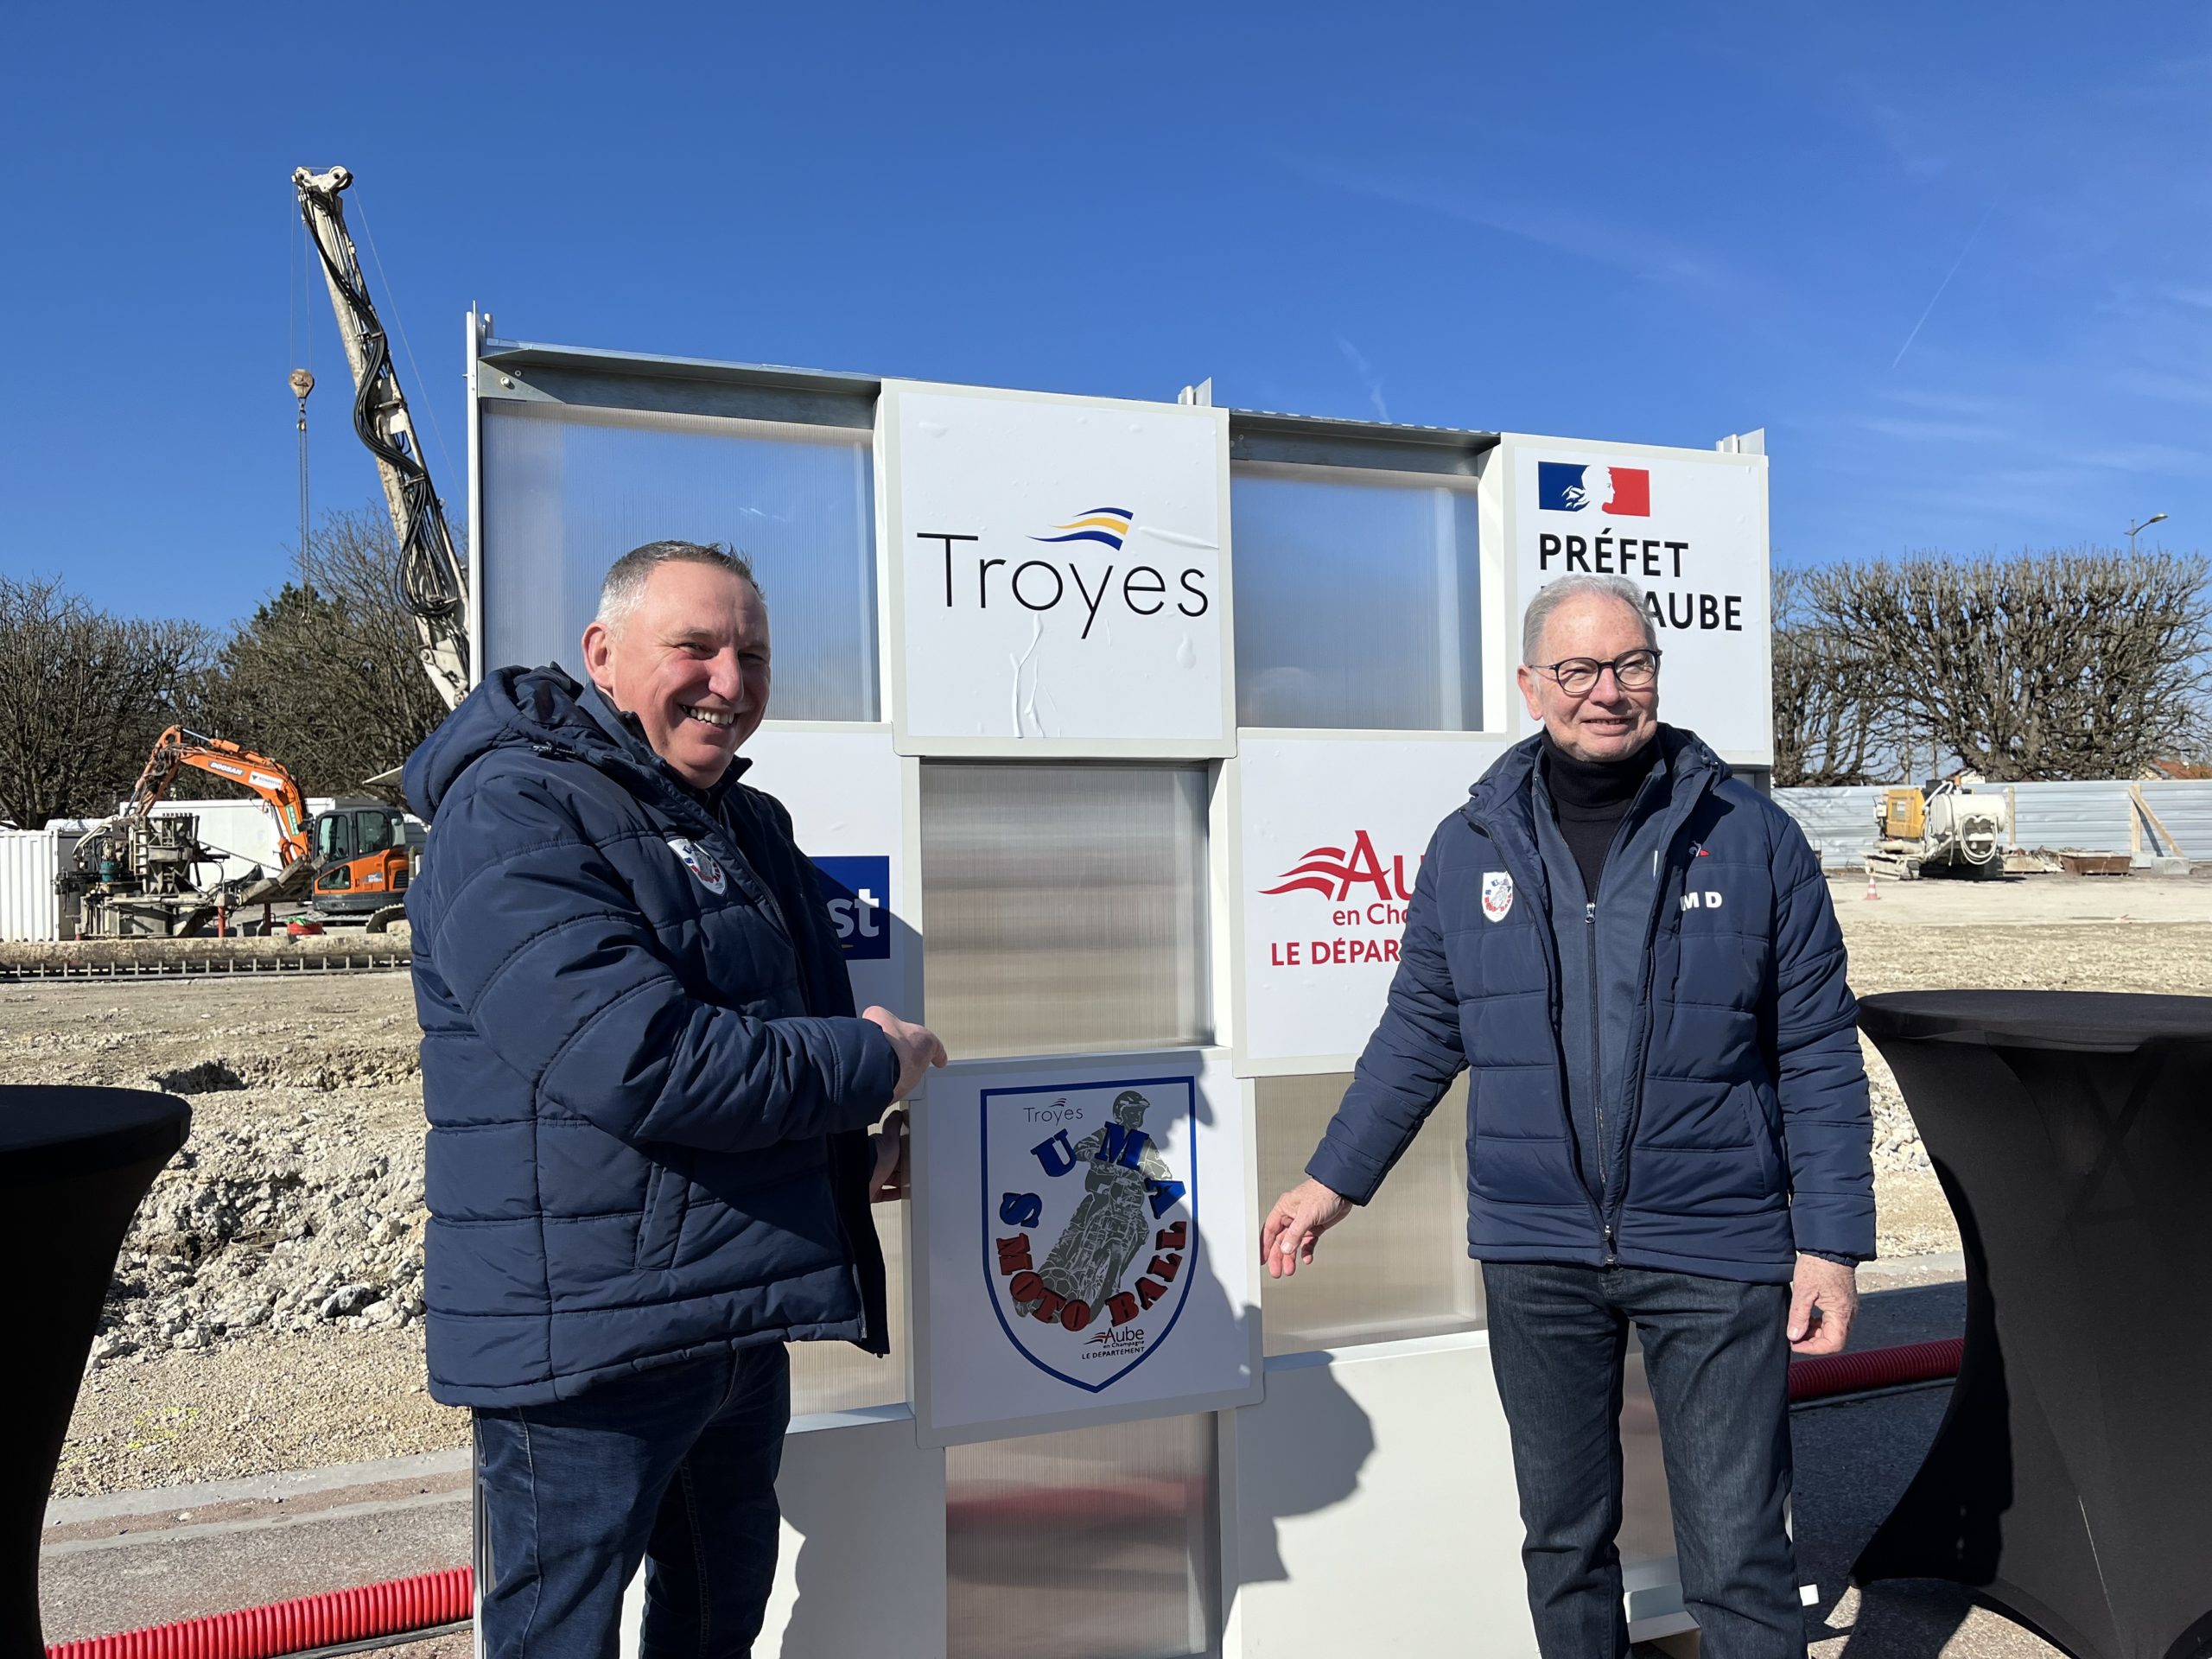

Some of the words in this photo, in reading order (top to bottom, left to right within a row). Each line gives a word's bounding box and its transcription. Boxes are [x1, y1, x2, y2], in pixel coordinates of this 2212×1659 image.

[1539, 527, 1689, 578] PRÉFET
[917, 532, 1209, 639] Troyes
[1332, 909, 1361, 925] en
[1271, 942, 1300, 966] LE
[1311, 938, 1402, 965] DÉPAR
[1022, 1107, 1084, 1127] Troyes
[999, 1121, 1186, 1229] SUMA
[1104, 1326, 1145, 1344] Aube
